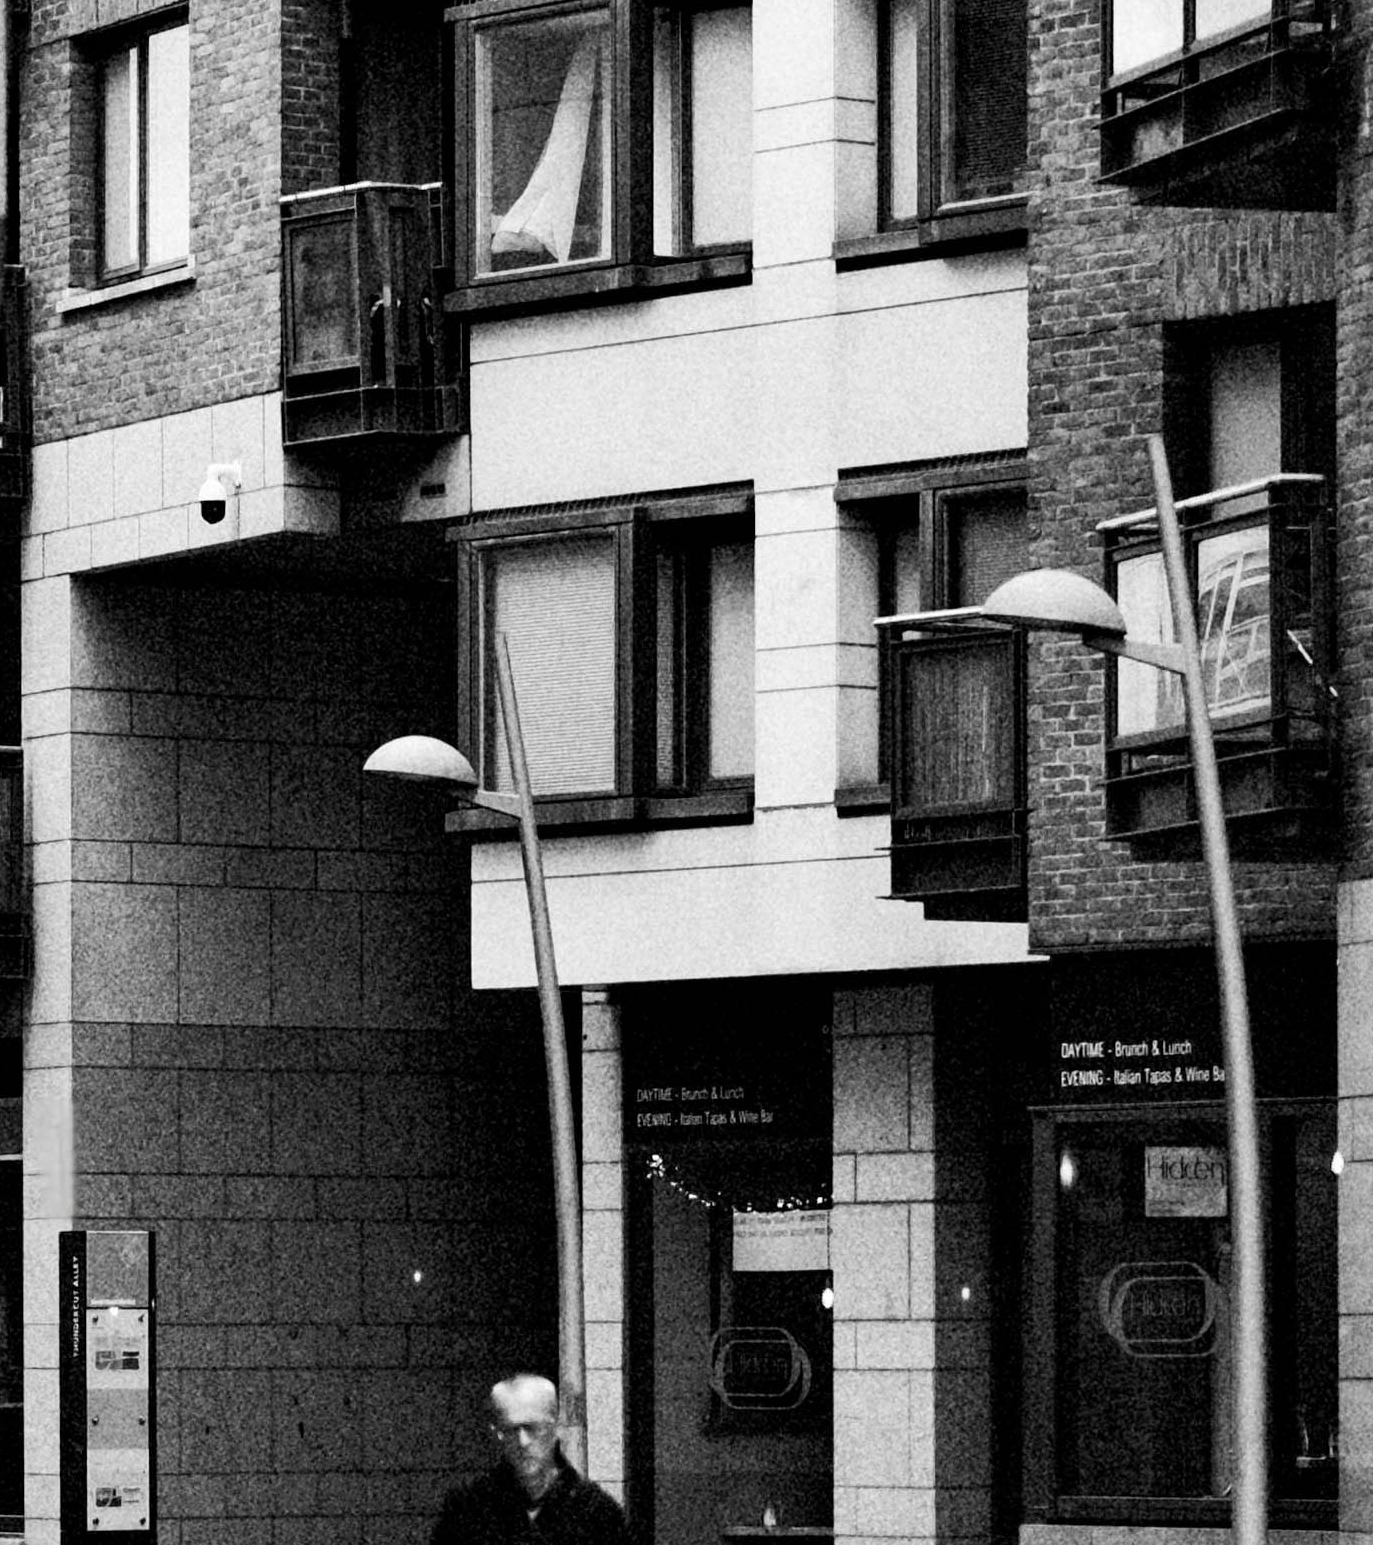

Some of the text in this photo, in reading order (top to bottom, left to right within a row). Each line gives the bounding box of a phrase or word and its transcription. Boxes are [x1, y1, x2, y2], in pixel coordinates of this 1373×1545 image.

[1061, 1041, 1105, 1058] DAYTIME
[1115, 1040, 1148, 1057] Brunch
[1152, 1040, 1160, 1056] &
[1163, 1039, 1192, 1055] Lunch
[1061, 1069, 1103, 1087] EVENING
[1114, 1069, 1141, 1085] Italian
[1144, 1068, 1172, 1086] Tapas
[1175, 1066, 1183, 1083] &
[1185, 1066, 1210, 1082] Wine
[1212, 1065, 1226, 1082] Ba
